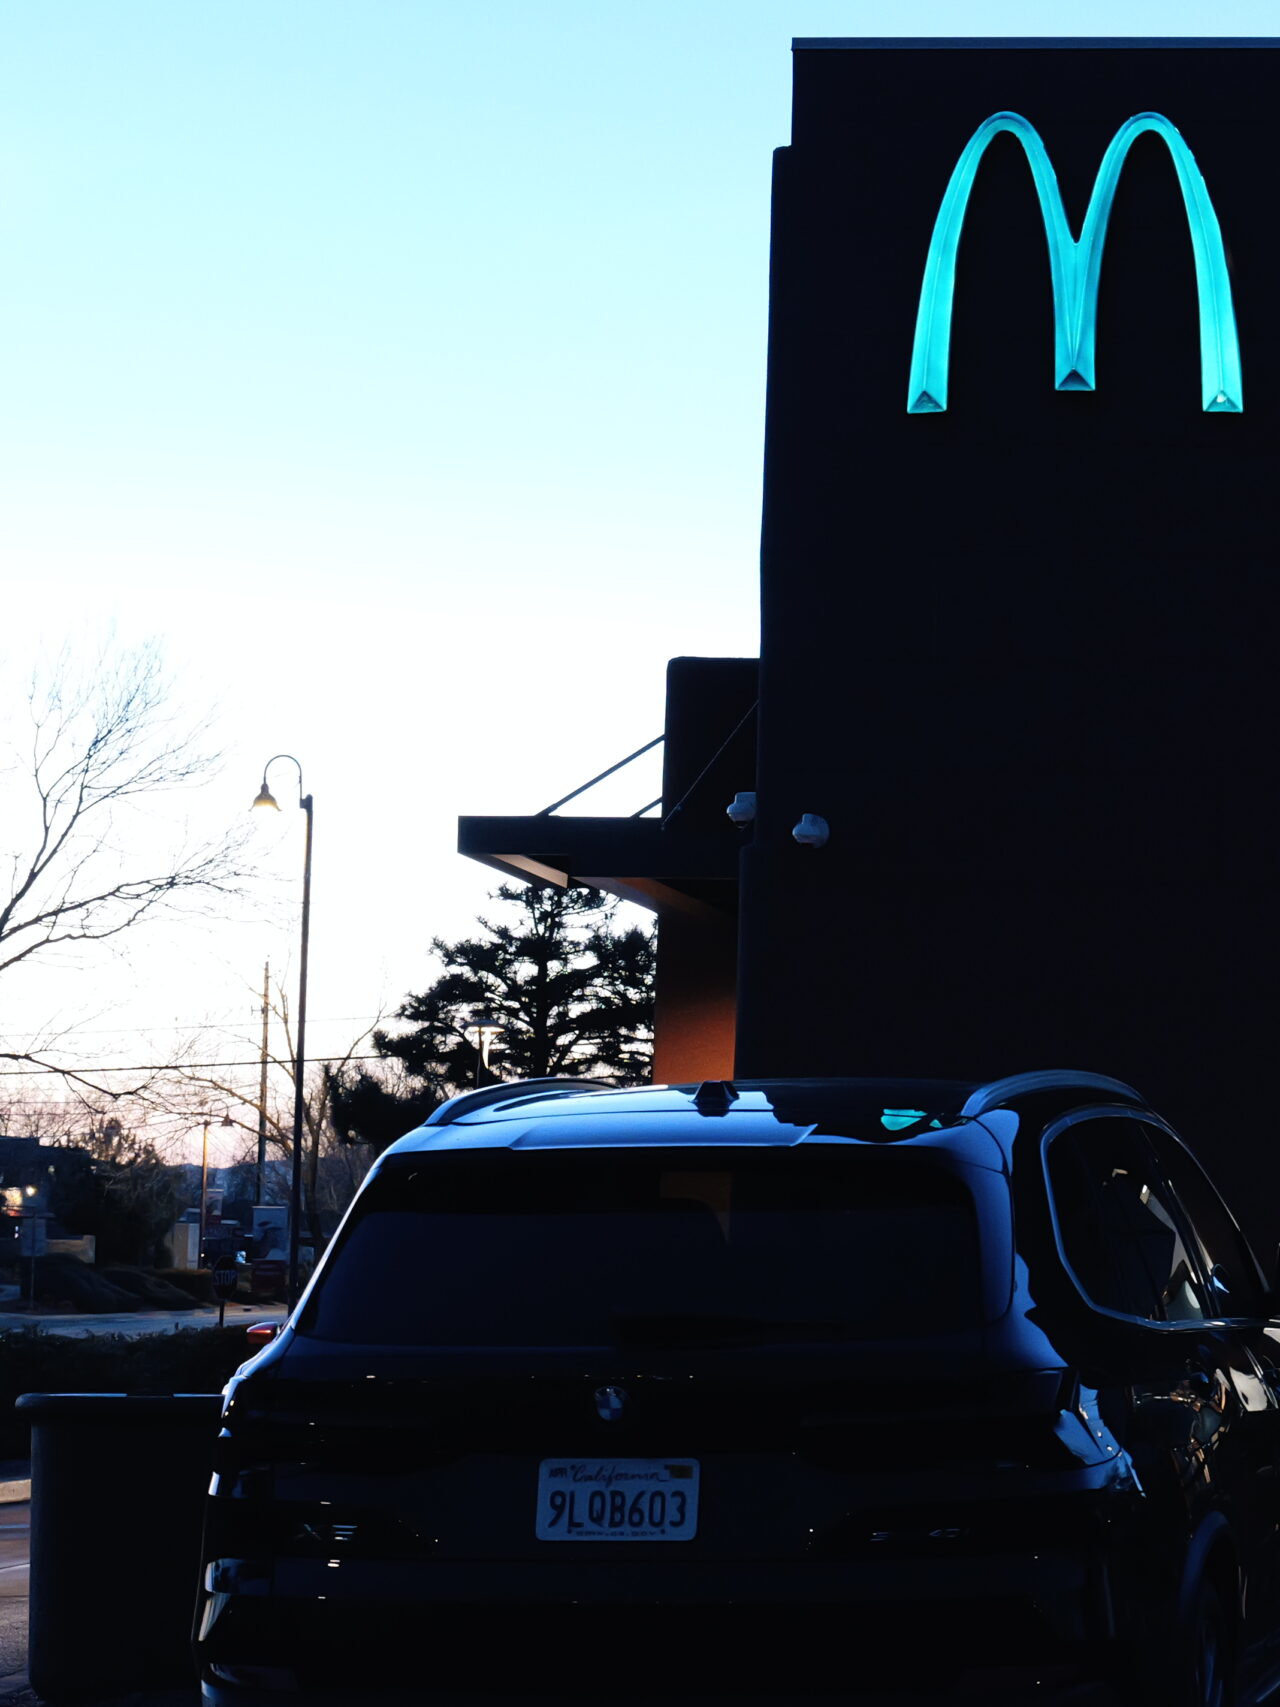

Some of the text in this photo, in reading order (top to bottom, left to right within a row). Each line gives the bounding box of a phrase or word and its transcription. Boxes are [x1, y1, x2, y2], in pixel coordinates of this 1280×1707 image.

[214, 1269, 238, 1286] STOP
[572, 1463, 670, 1488] California
[548, 1490, 687, 1528] 9LQB603
